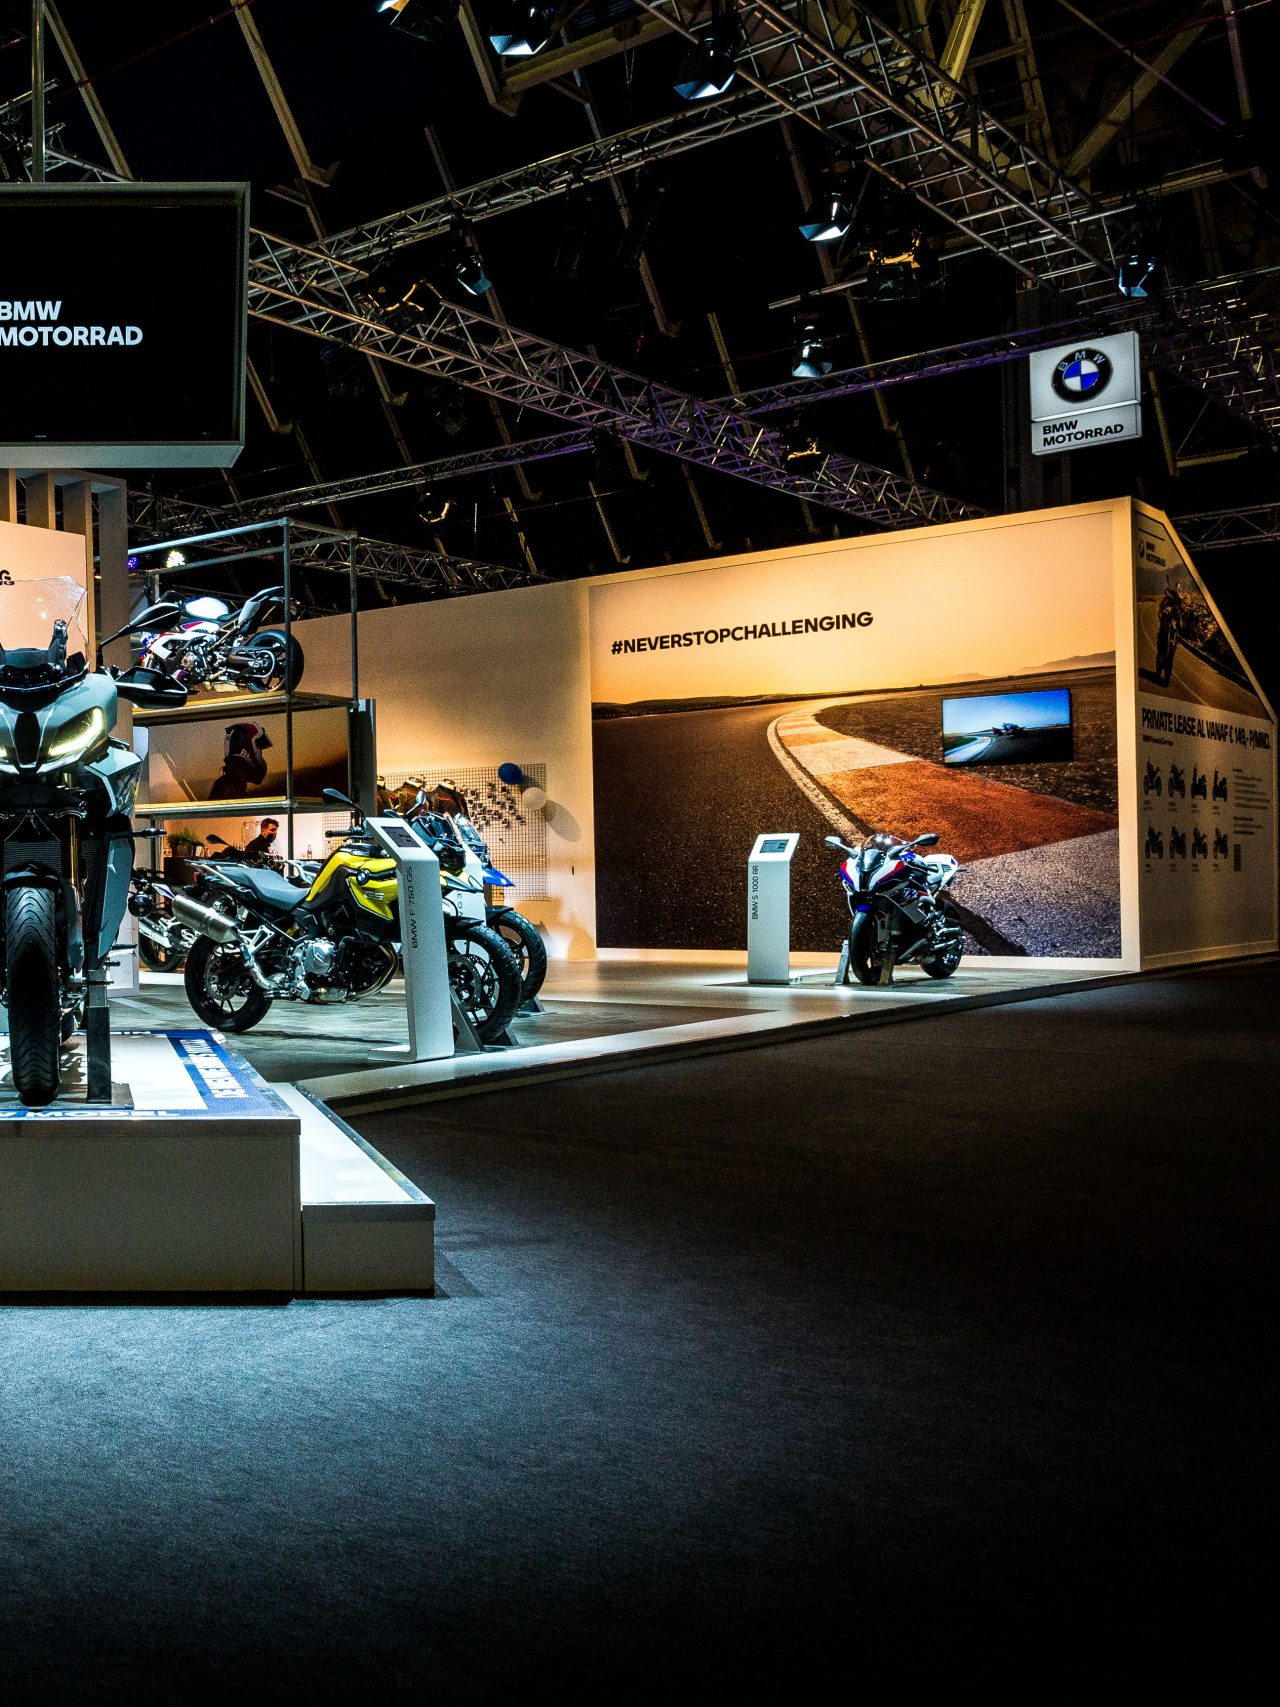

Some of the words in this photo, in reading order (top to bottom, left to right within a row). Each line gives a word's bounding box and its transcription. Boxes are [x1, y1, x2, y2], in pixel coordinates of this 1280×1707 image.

[1058, 350, 1106, 371] BMW
[1042, 420, 1078, 435] BMW
[1042, 424, 1124, 447] MOTORRAD
[611, 611, 874, 655] #NEVERSTOPCHALLENGING
[1141, 707, 1173, 732] PRIVATE
[1174, 714, 1196, 736] LEASE
[1206, 720, 1229, 742] VANAF
[406, 866, 413, 882] GS
[751, 876, 759, 893] 1000
[407, 885, 416, 906] 750
[751, 901, 759, 920] BMW
[410, 920, 419, 949] BMW
